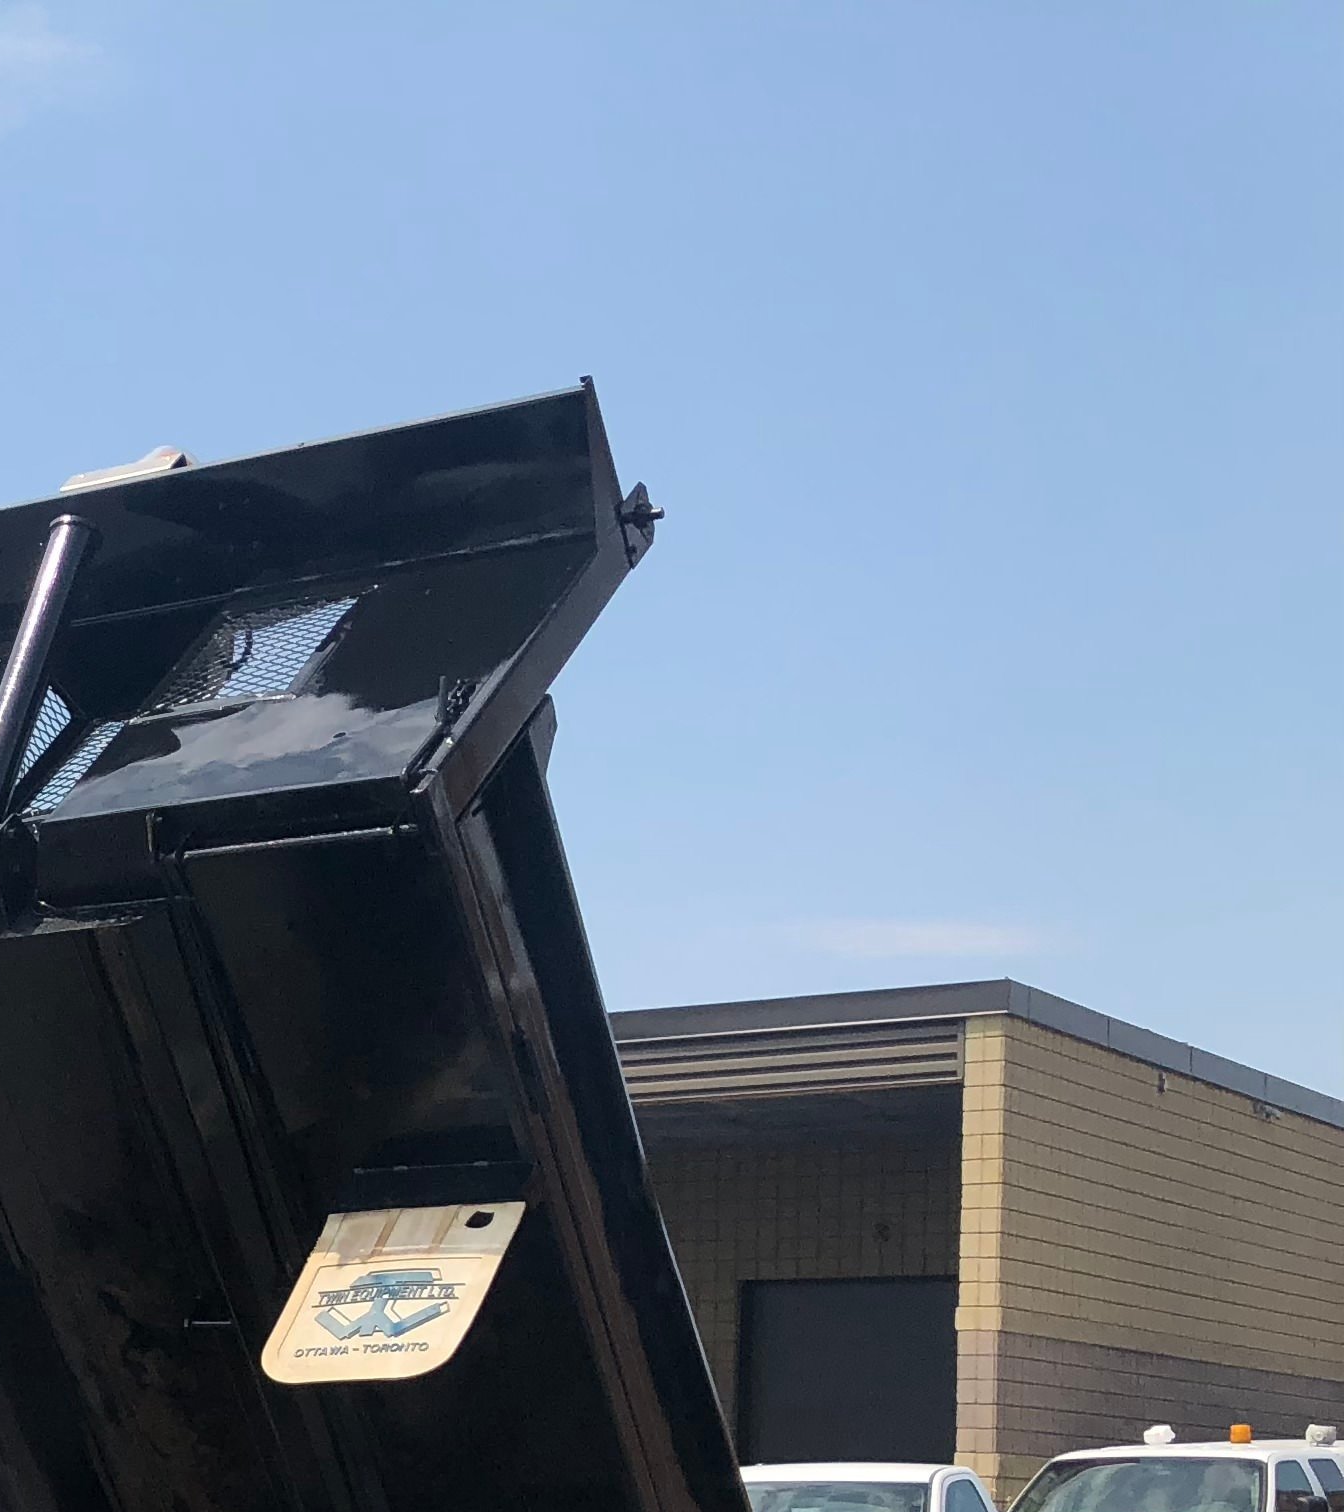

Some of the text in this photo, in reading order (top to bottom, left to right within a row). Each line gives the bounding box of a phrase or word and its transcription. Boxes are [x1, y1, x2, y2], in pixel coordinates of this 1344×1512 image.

[351, 1284, 423, 1302] EQUIPMENT
[294, 1345, 349, 1358] OTTAWA
[362, 1341, 430, 1354] TORONTO
